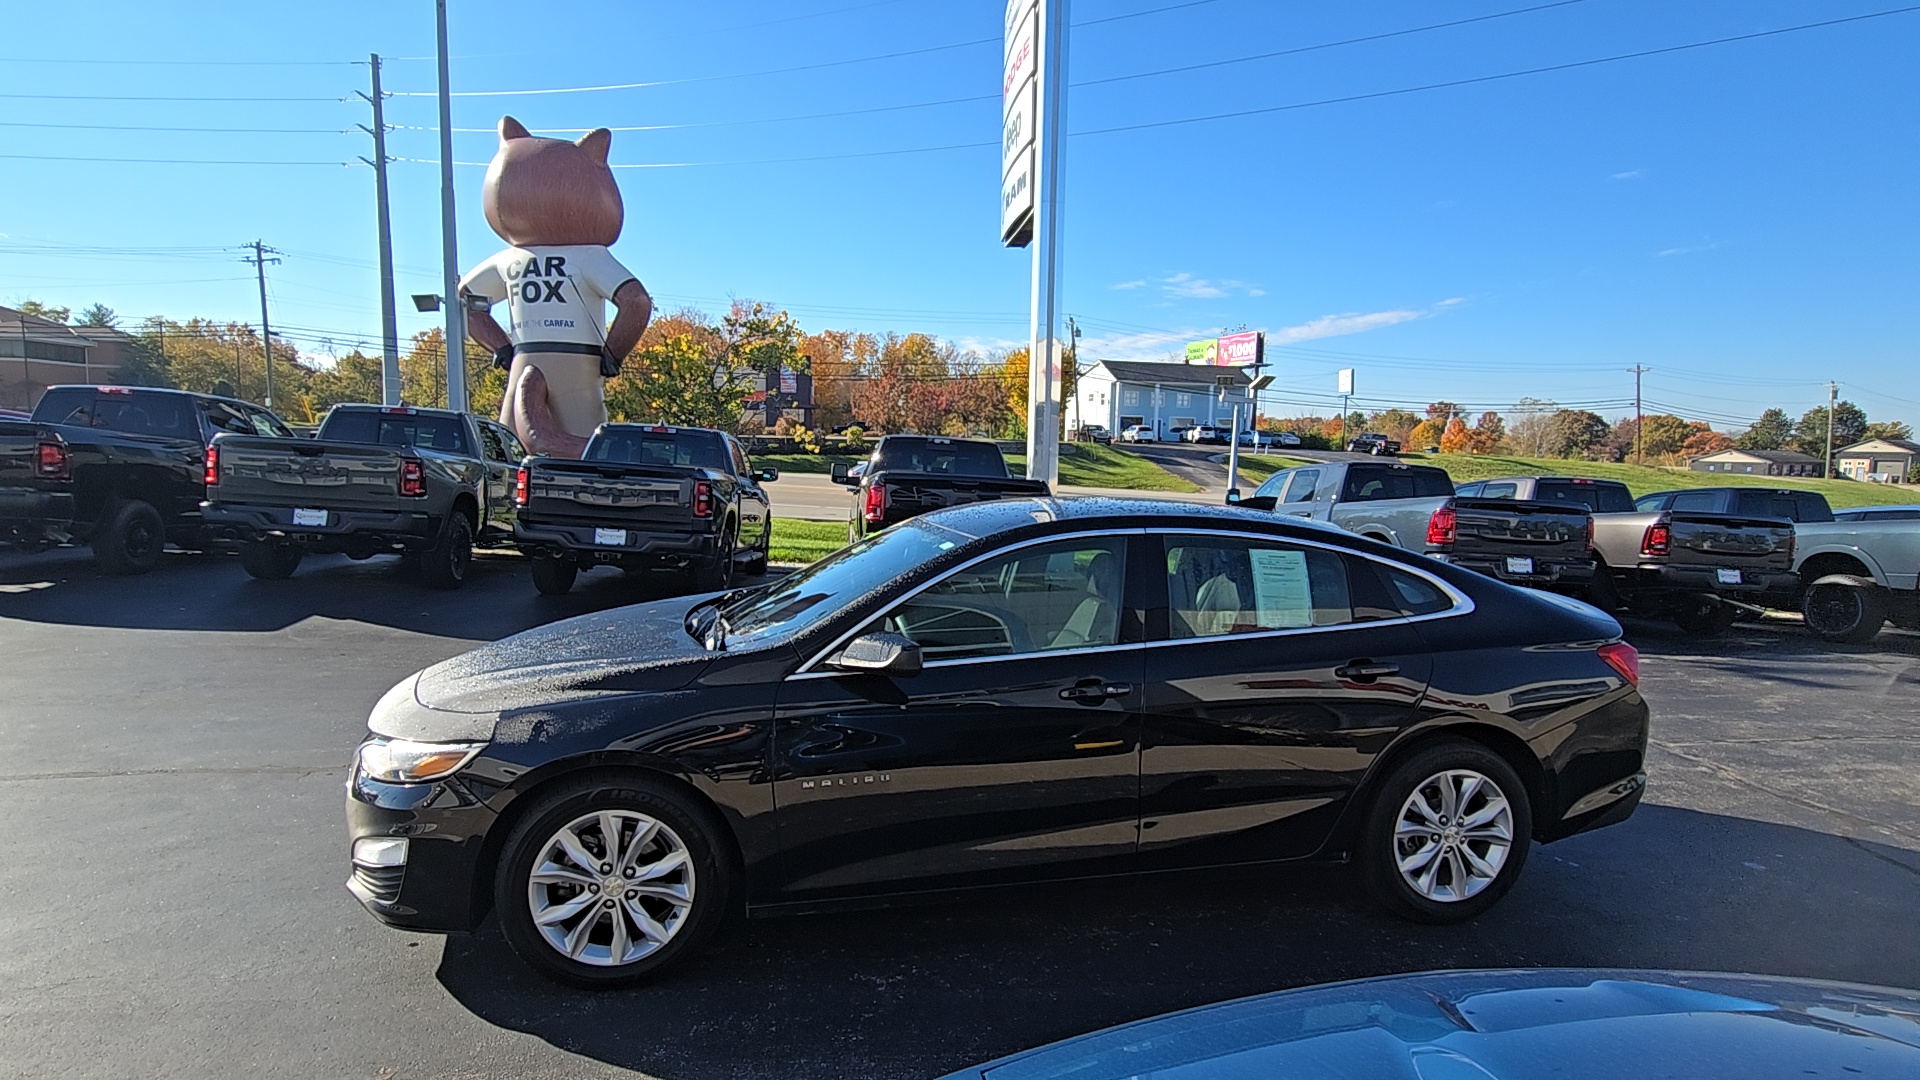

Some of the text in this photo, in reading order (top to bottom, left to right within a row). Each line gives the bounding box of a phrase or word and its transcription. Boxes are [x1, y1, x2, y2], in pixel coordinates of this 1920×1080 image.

[1005, 170, 1027, 211] RAM
[506, 256, 567, 281] CAR
[509, 280, 568, 306] FOX
[543, 319, 575, 328] CARFAX
[266, 462, 349, 477] RAM
[574, 484, 649, 498] RAM
[1701, 531, 1768, 545] RAM
[802, 774, 890, 788] MALIBU
